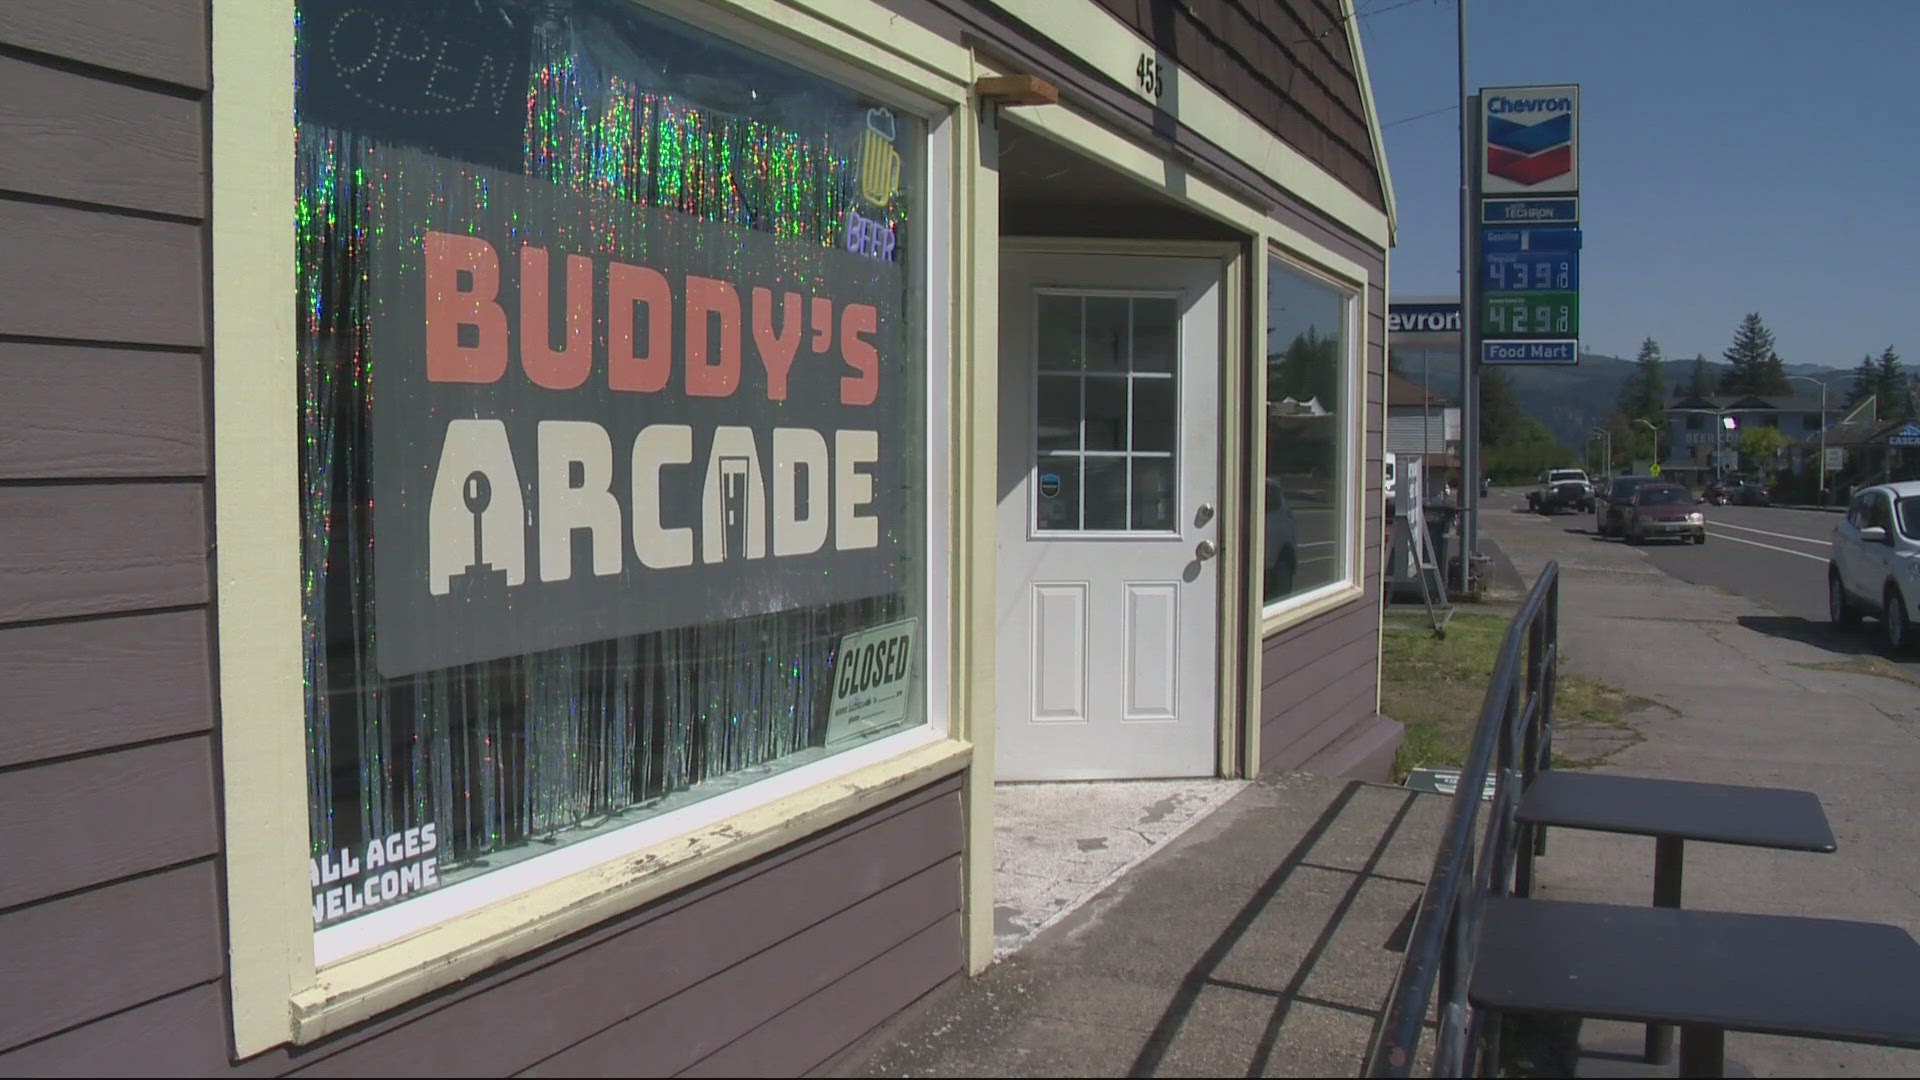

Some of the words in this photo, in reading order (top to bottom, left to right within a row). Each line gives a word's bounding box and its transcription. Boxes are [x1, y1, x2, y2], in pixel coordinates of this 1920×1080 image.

[328, 8, 514, 115] OPEN
[1136, 53, 1162, 97] 455
[1487, 96, 1571, 113] Chevron
[847, 211, 896, 262] BEER
[1505, 207, 1554, 218] TECHRON
[425, 231, 879, 405] BUDDY'S
[1389, 312, 1460, 330] evron
[1490, 345, 1525, 358] Food
[1531, 344, 1567, 357] Mart
[429, 419, 879, 595] ARCADE
[838, 635, 909, 699] CLOSED
[366, 822, 437, 870] AGES
